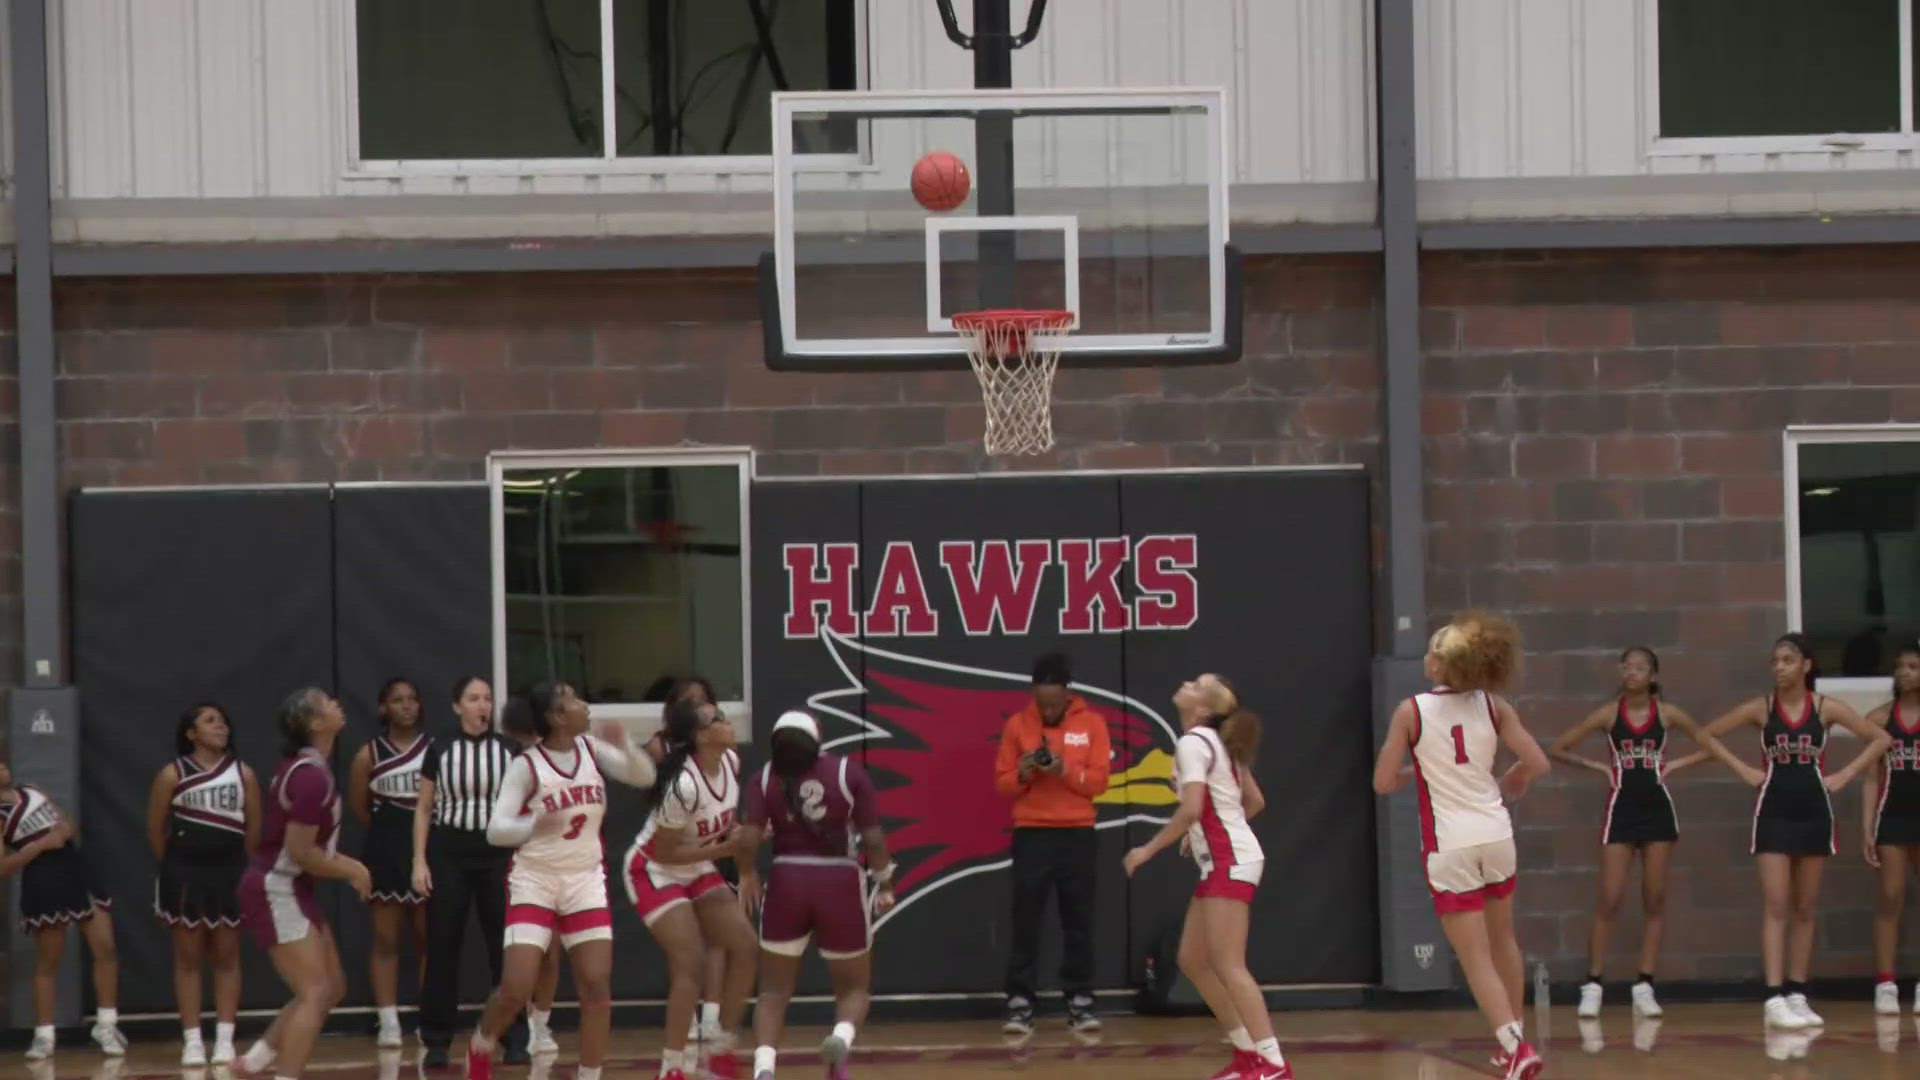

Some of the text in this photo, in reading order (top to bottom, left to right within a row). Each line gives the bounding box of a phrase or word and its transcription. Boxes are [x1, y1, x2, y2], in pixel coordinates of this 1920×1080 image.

[783, 533, 1199, 640] HAWKS
[1450, 724, 1470, 765] 1
[377, 770, 421, 793] RITTE
[542, 784, 604, 813] HAWKS
[799, 779, 827, 820] 2
[562, 812, 587, 840] 3
